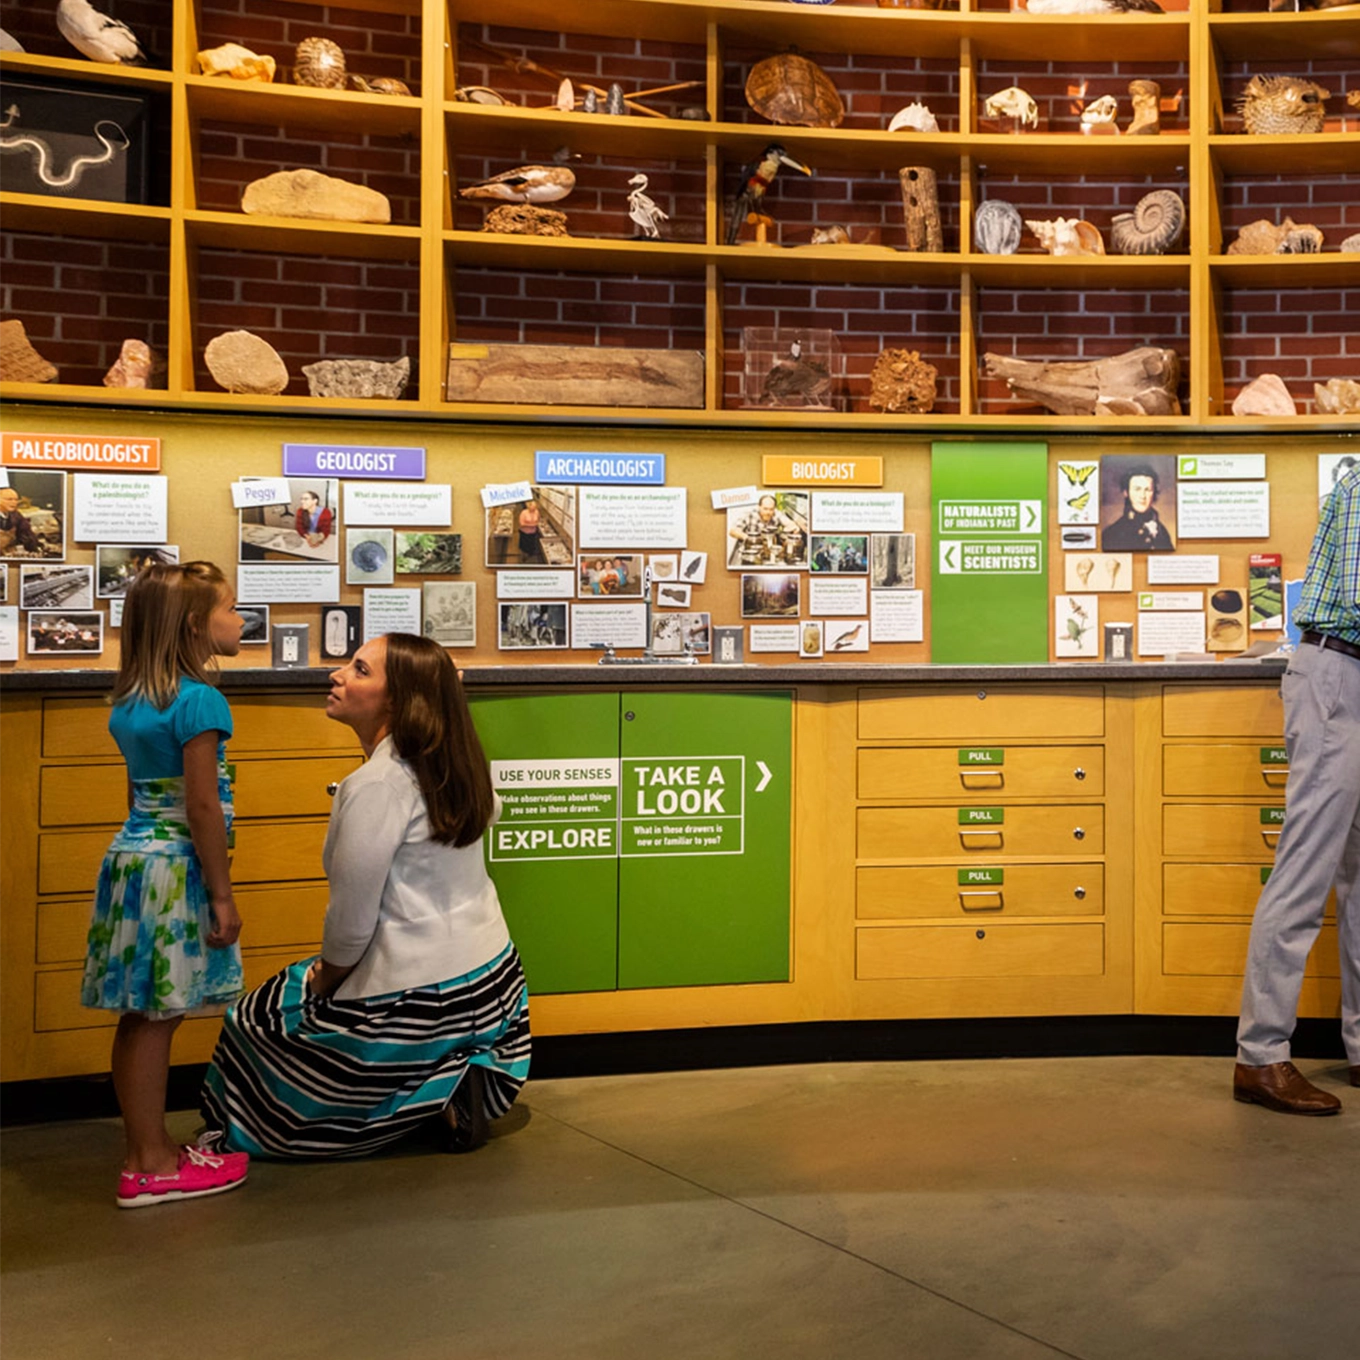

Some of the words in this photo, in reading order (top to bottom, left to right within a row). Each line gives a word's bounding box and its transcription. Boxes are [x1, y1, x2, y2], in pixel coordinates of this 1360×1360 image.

[12, 440, 151, 463] PALEOBIOLOGIST
[316, 451, 397, 471] GEOLOGIST
[547, 459, 656, 477] ARCHAEOLOGIST
[792, 463, 856, 479] BIOLOGIST
[245, 487, 277, 501] Peggy
[489, 487, 525, 502] Michele
[944, 506, 1017, 517] NATURALISTS
[944, 519, 954, 528] OF
[955, 519, 995, 528] INDIANA'S
[996, 519, 1016, 528] PAST
[963, 545, 984, 554] MEET
[985, 545, 1002, 554] OUR
[1003, 545, 1036, 554] MUSEUM
[963, 556, 1037, 569] SCIENTISTS
[969, 752, 992, 761] PULL
[1270, 751, 1288, 759] PUL
[500, 770, 524, 782] USE
[528, 769, 561, 781] YOUR
[564, 768, 612, 780] SENSES
[634, 766, 701, 786] TAKE
[707, 766, 725, 785] A
[520, 794, 566, 803] observations
[568, 793, 588, 802] about
[589, 792, 612, 803] things
[637, 788, 726, 815] LOOK
[510, 807, 522, 816] you
[549, 805, 568, 813] these
[570, 804, 600, 813] drawers.
[969, 811, 992, 820] PULL
[633, 825, 652, 835] What
[654, 825, 661, 834] in
[663, 825, 683, 834] these
[685, 824, 714, 833] drawers
[716, 824, 723, 833] is
[498, 828, 612, 851] EXPLORE
[654, 838, 662, 846] or
[664, 837, 693, 846] familiar
[694, 837, 702, 845] to
[704, 835, 721, 847] you?
[969, 871, 992, 880] PULL
